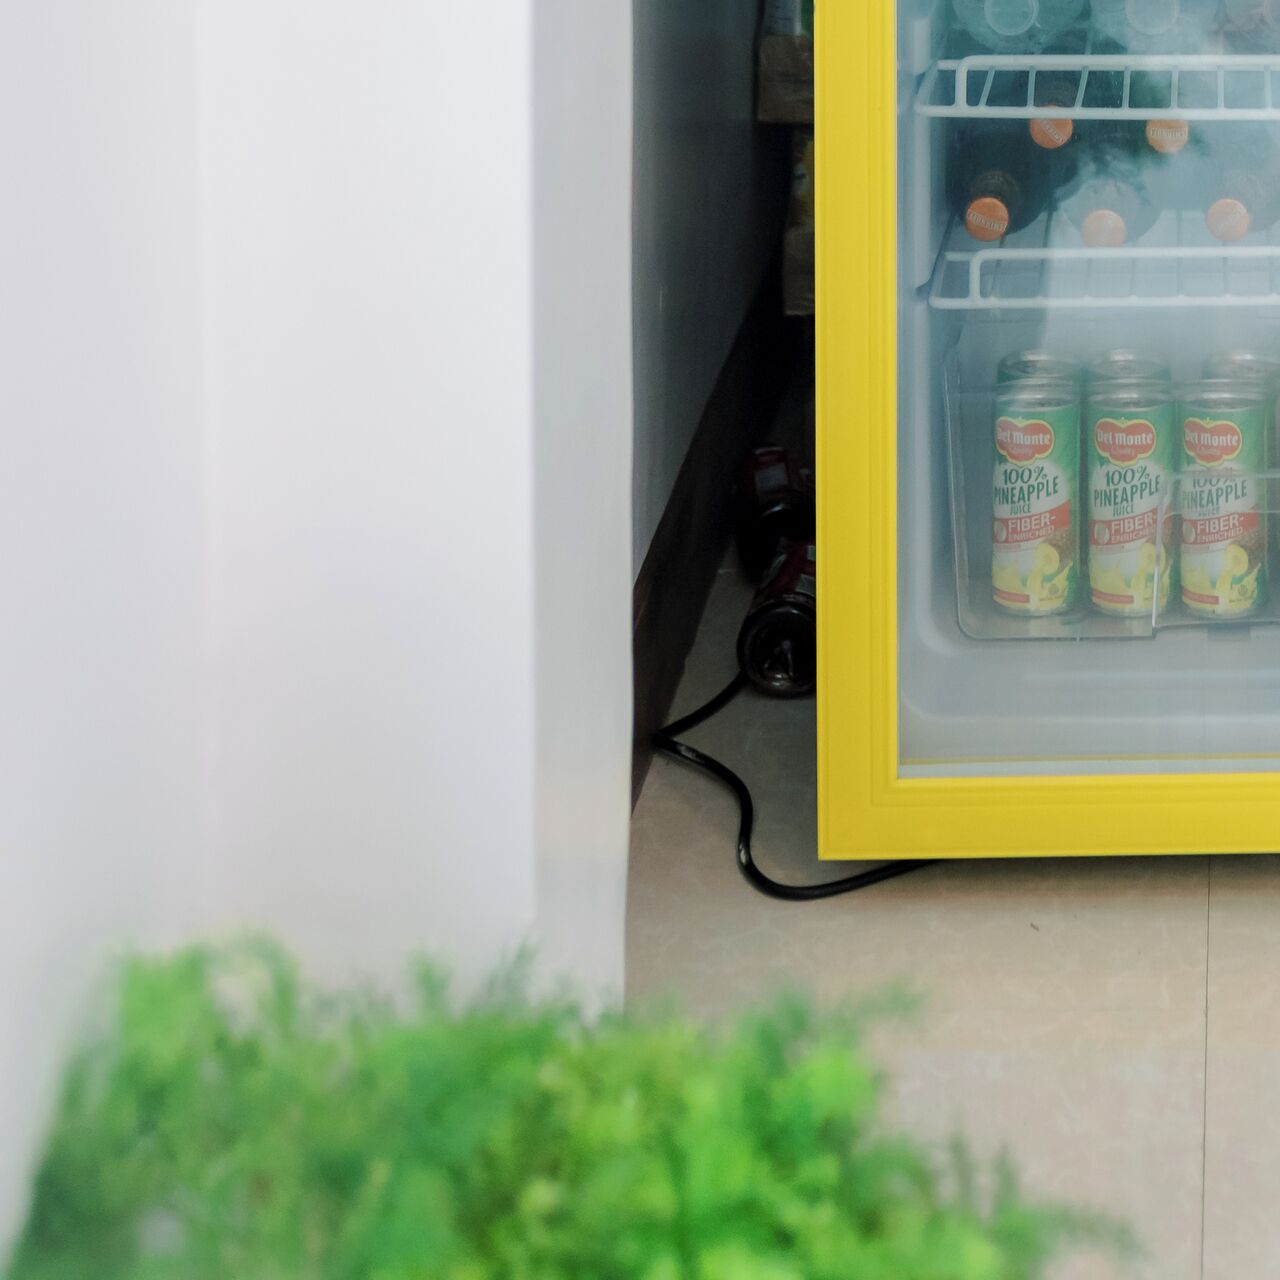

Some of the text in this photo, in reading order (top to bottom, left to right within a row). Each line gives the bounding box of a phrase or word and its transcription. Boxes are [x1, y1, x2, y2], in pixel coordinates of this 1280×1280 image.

[1012, 431, 1051, 446] Monte
[1115, 431, 1153, 446] Monte
[1200, 433, 1239, 446] Monte
[1003, 466, 1048, 486] 100%
[1105, 465, 1150, 488] 100%
[993, 476, 1059, 505] PINEAPPLE
[1093, 474, 1161, 508] PINEAPPLE
[1182, 479, 1248, 510] PINEAPPLE
[1009, 503, 1032, 516] JUICE
[1112, 503, 1135, 518] JUICE
[1008, 512, 1057, 532] FIBER-
[1197, 513, 1244, 534] FIBER-
